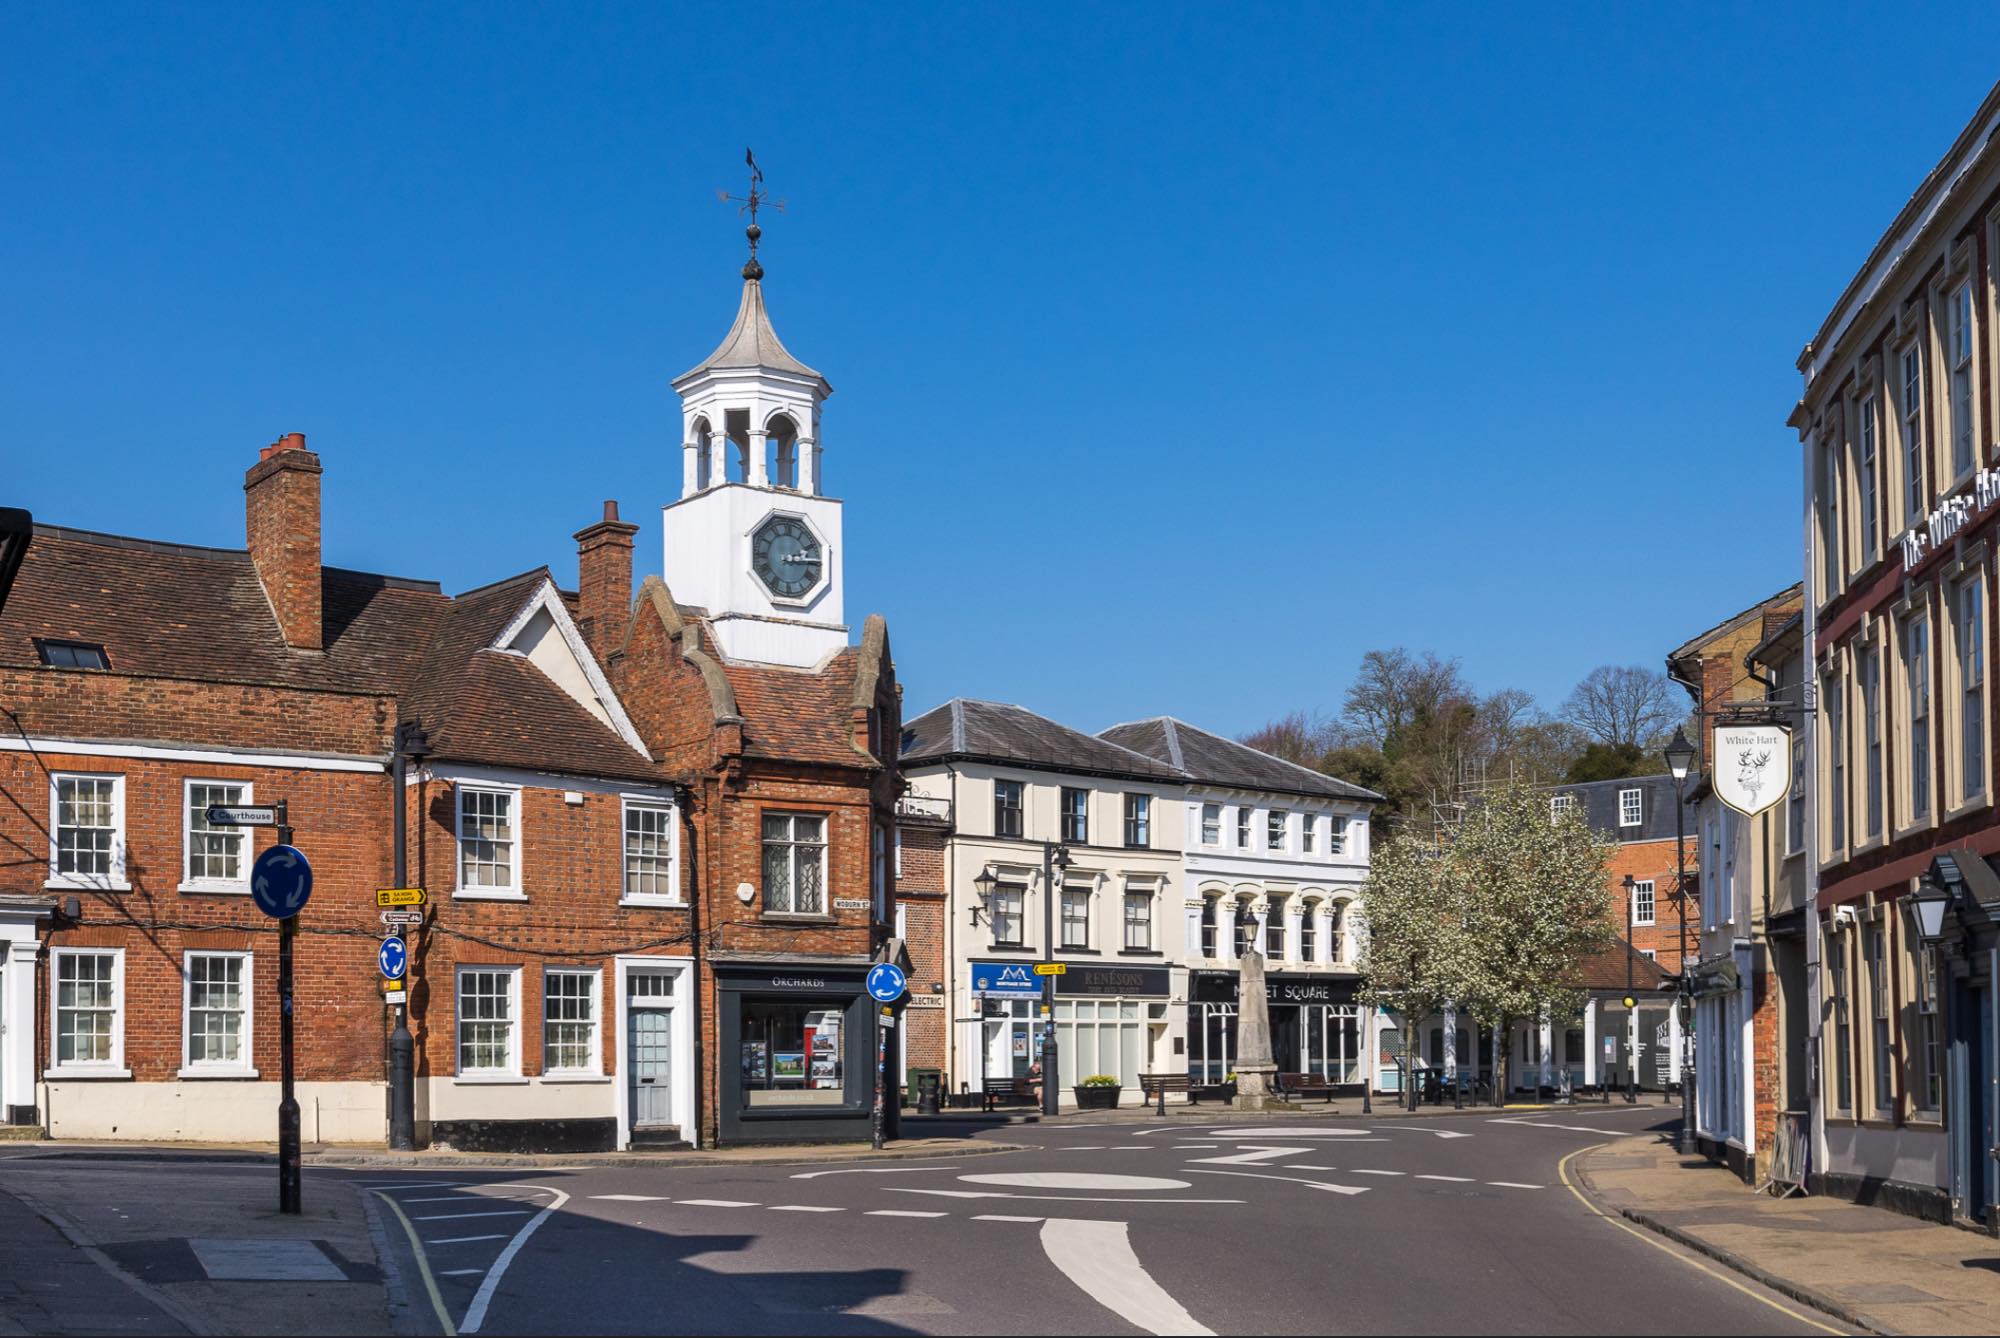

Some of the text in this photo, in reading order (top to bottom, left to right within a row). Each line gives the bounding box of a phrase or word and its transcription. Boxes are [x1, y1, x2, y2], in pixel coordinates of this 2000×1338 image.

[1726, 736, 1777, 745] White Hart
[219, 811, 272, 821] Courthouse
[772, 976, 825, 988] ORCHARDS
[1233, 985, 1329, 1000] MET SQUARE
[911, 997, 942, 1006] ELECTRIC
